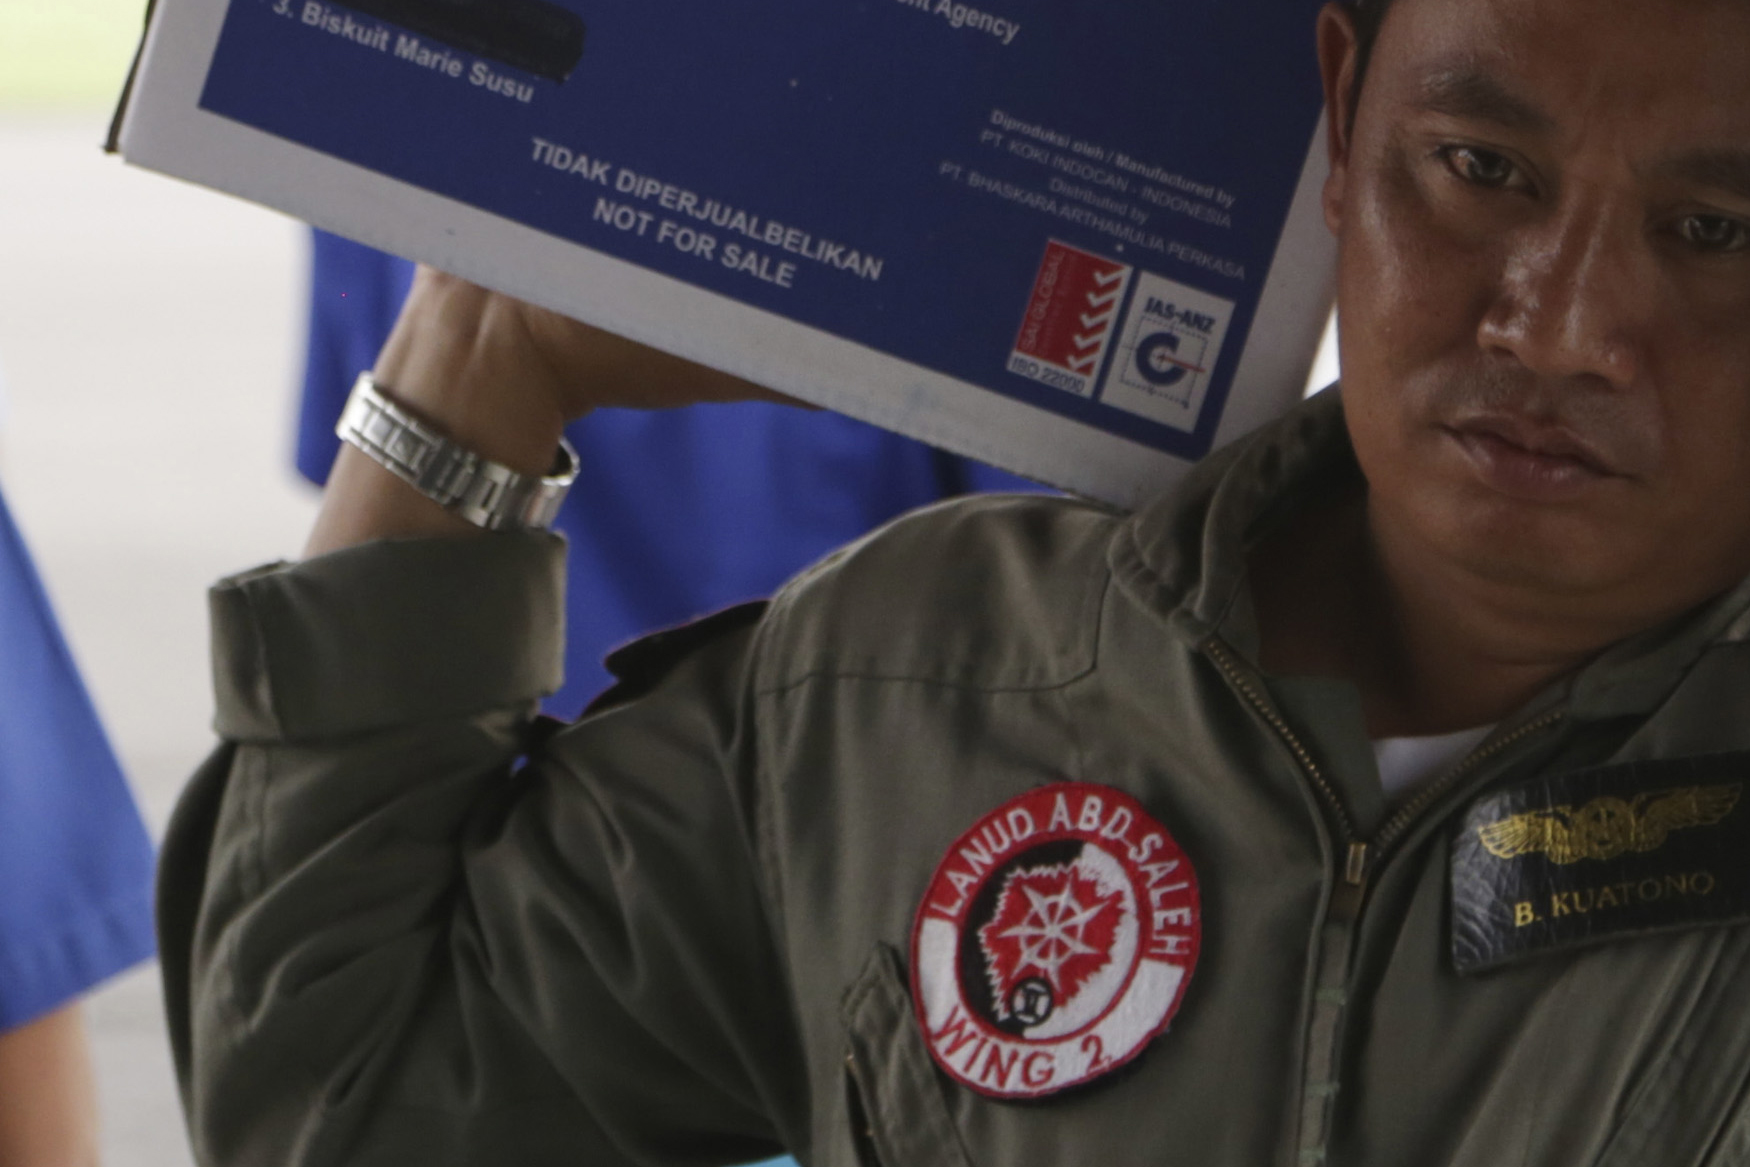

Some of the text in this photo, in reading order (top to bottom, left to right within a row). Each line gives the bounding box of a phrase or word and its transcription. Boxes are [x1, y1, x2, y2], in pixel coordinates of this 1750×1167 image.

[301, 0, 390, 52] Biskuit
[394, 34, 463, 78] Marie
[469, 61, 535, 104] Susu
[990, 109, 1070, 149] Diproduksi
[1072, 139, 1104, 161] oleh
[1115, 153, 1214, 200] Manufactured
[1217, 185, 1236, 208] by
[1050, 178, 1150, 226] Distributed by
[531, 137, 883, 281] TIDAK DIPERJUALBELIKAN
[593, 198, 797, 288] NOT FOR SALE
[1141, 184, 1232, 229] INDONESIA
[930, 807, 1035, 917] LANUD
[1129, 832, 1192, 955] SALEH
[1514, 870, 1715, 928] B. KUATONO
[933, 1004, 1112, 1089] WING 2
